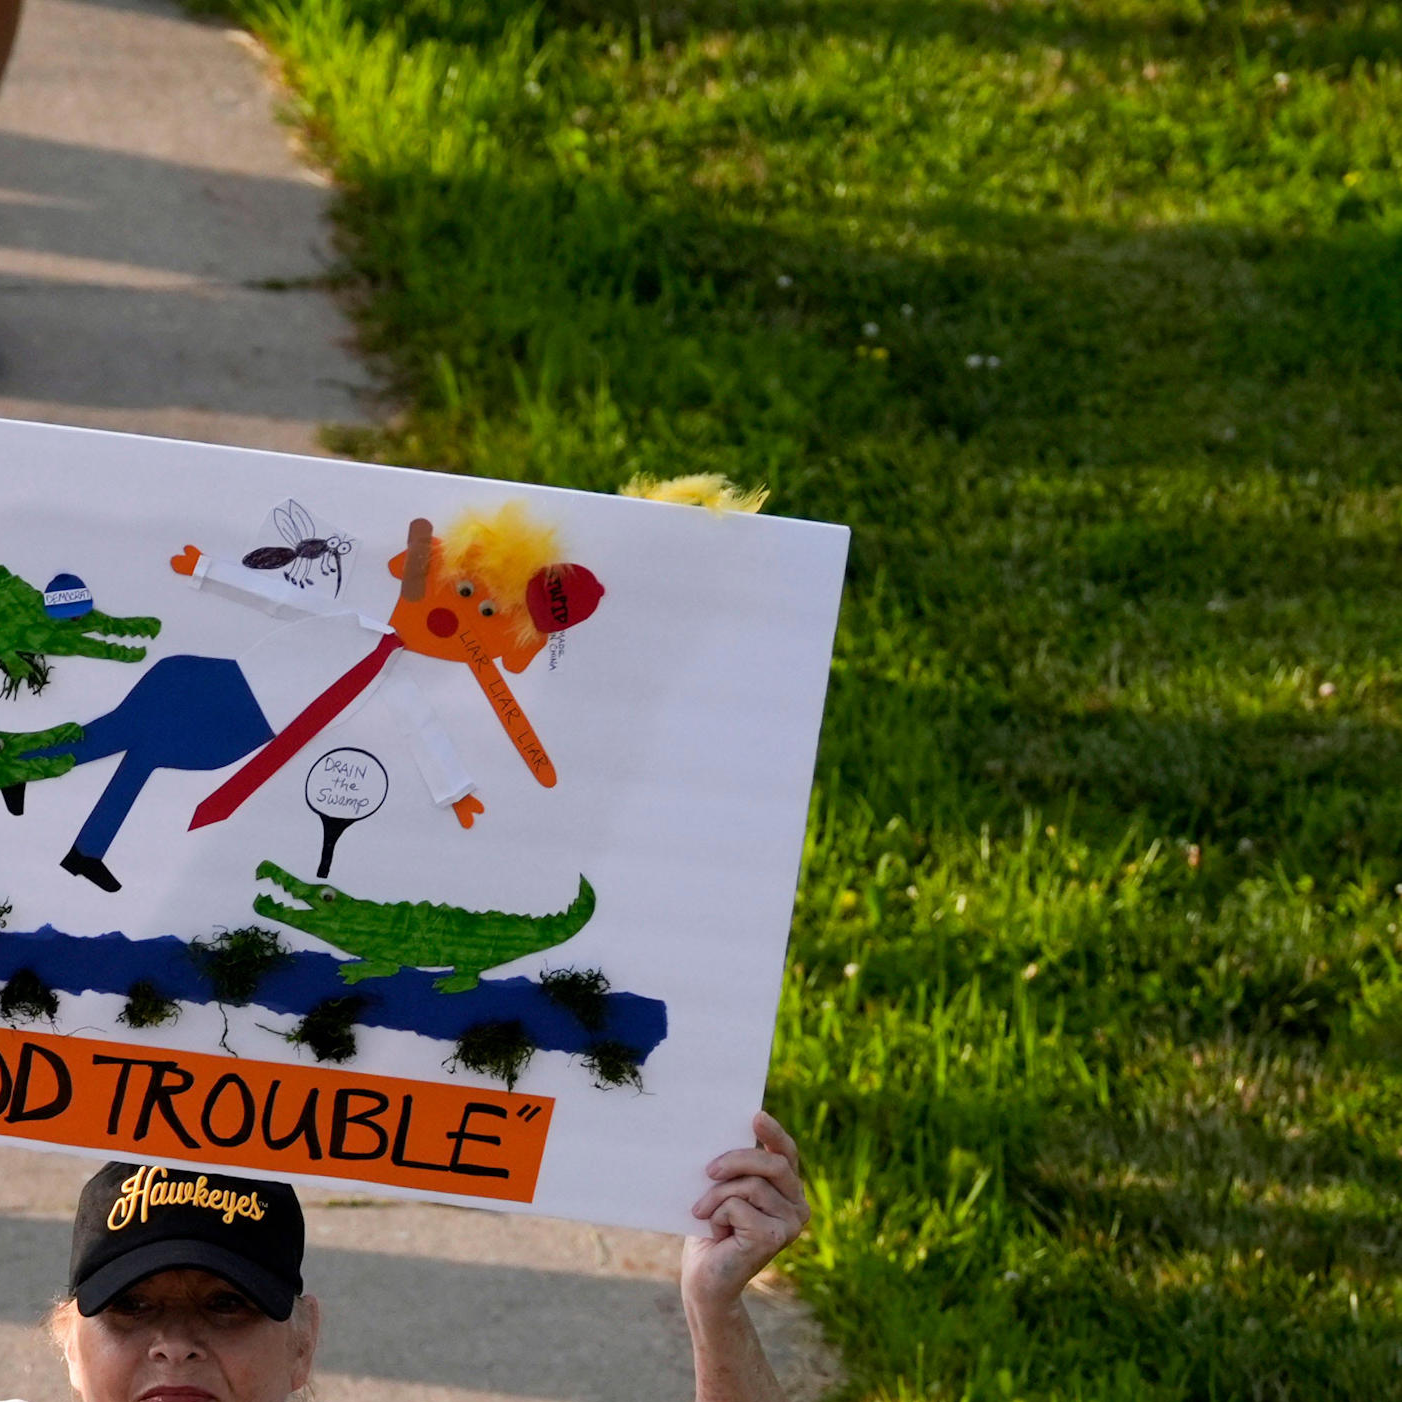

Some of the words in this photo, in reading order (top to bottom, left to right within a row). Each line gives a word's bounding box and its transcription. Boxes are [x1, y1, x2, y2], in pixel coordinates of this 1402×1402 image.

[459, 630, 489, 673] LIAR
[489, 679, 520, 725] LIAR
[517, 731, 549, 772] LIAR
[324, 757, 368, 779] DRAIN
[332, 776, 359, 792] the
[92, 1053, 543, 1179] TROUBLE"
[107, 1165, 265, 1231] Hawkeyes
